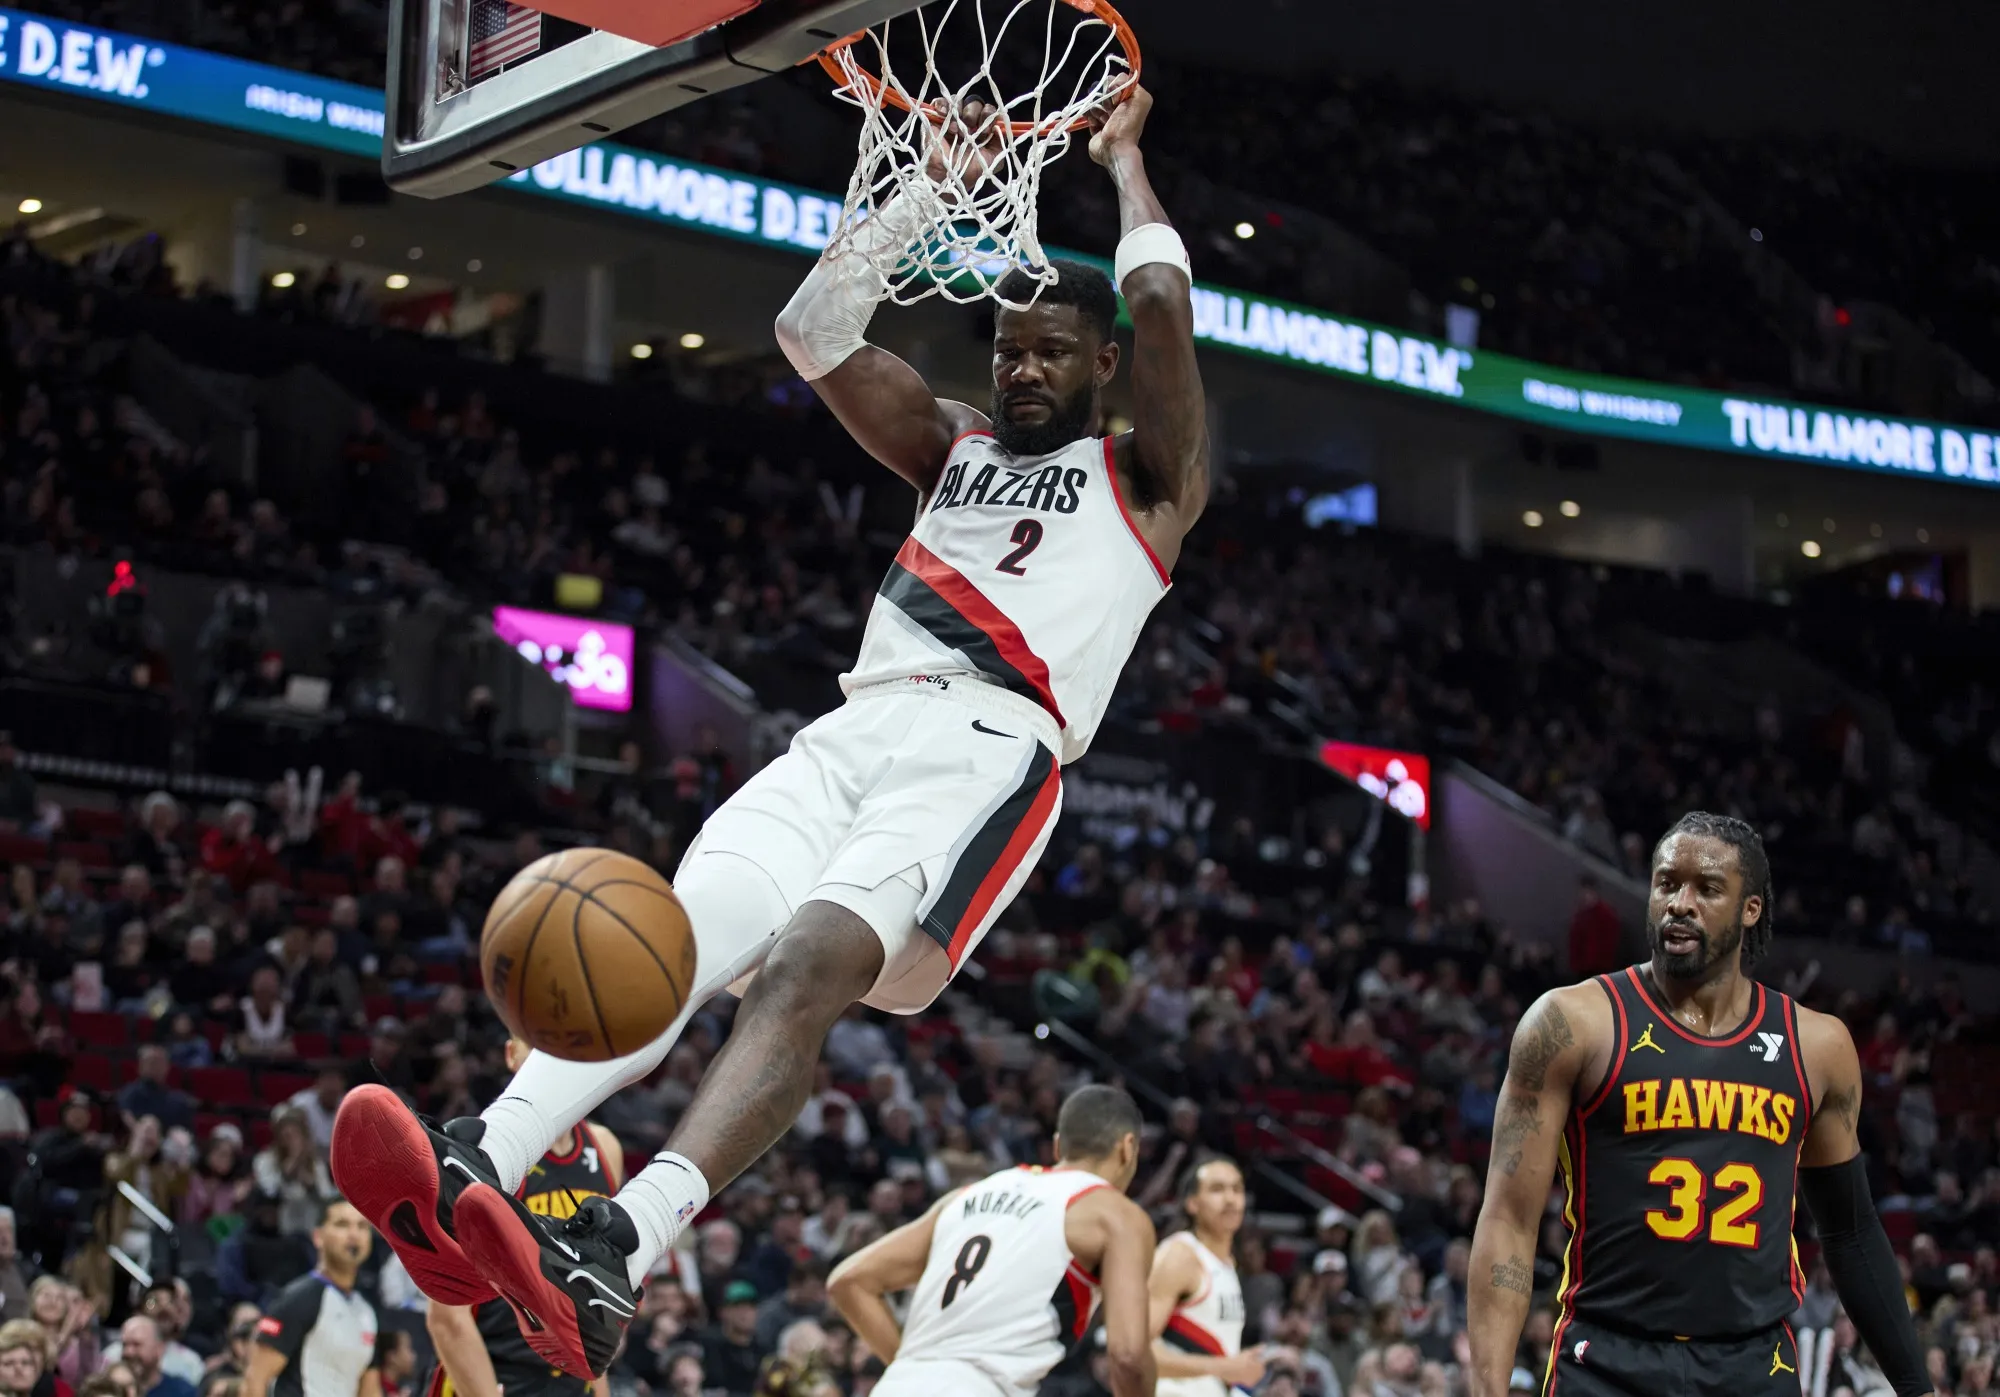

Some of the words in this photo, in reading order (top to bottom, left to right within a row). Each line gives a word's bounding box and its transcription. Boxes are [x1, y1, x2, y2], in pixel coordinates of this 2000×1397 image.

[507, 144, 757, 234] ULLAMORE
[1190, 286, 1369, 374] ULLAMORE
[1722, 399, 1936, 472] TULLAMORE
[930, 461, 1088, 514] BLAZERS
[995, 518, 1043, 577] 2
[1623, 1077, 1797, 1146] HAWKS
[1644, 1156, 1766, 1250] 32
[941, 1234, 992, 1311] 8
